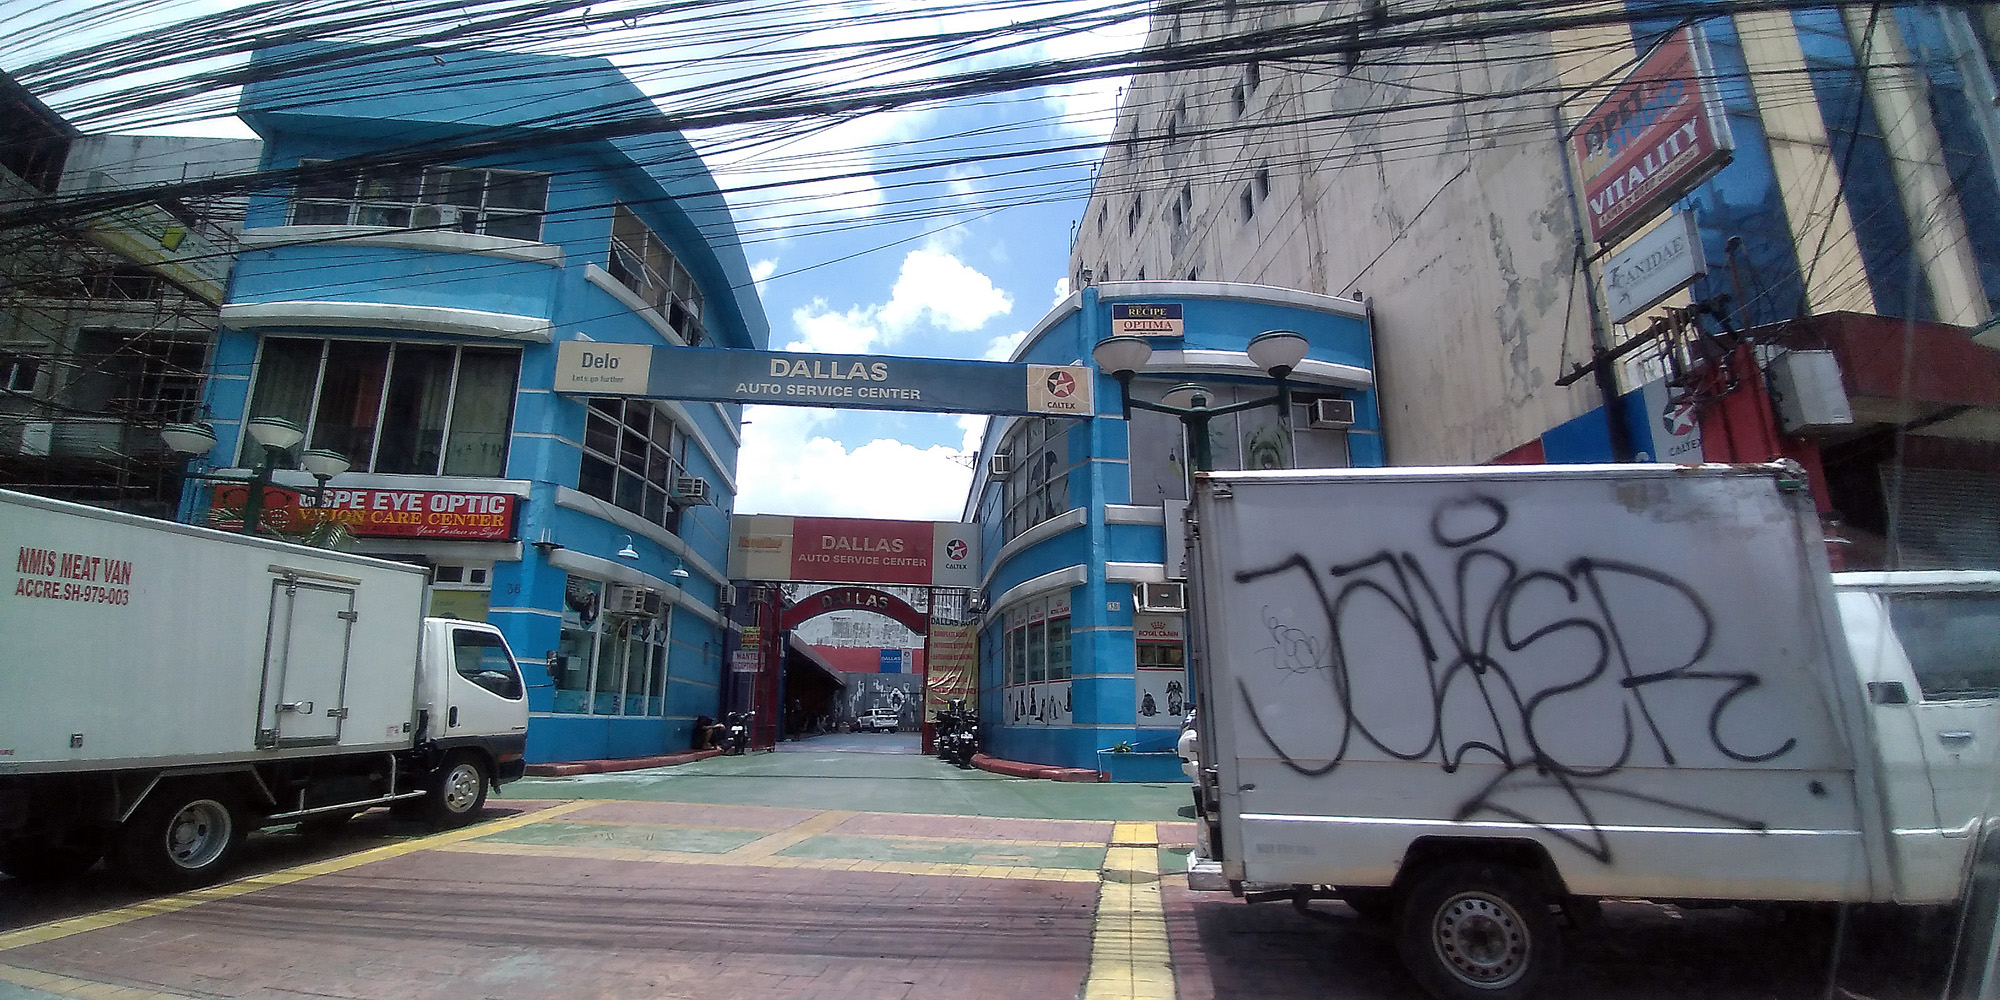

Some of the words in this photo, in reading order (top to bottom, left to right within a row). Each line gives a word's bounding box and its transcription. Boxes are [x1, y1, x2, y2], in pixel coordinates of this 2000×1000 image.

[1606, 79, 1684, 158] STUDIO
[1590, 115, 1698, 215] VITALITY
[1616, 236, 1684, 289] CANIDAE
[1128, 308, 1167, 316] RECIPE
[1123, 321, 1172, 329] OPTIMA
[582, 352, 619, 369] Delo
[770, 358, 889, 381] DALLAS
[735, 382, 782, 395] AUTO
[786, 384, 853, 397] SERVICE
[858, 386, 921, 400] CENTER
[1047, 401, 1076, 409] CALTEX
[372, 492, 425, 512] EYE
[430, 494, 507, 514] OPTIC
[371, 510, 423, 524] CARE
[428, 513, 505, 527] CENTER
[416, 525, 436, 536] Your
[479, 526, 504, 538] Sight
[821, 535, 904, 553] DALLAS
[16, 546, 57, 576] NMIS
[59, 553, 101, 582] MEAT
[104, 558, 132, 585] VAN
[798, 553, 830, 563] AUTO
[832, 555, 880, 565] SERVICE
[882, 557, 927, 567] CENTER
[930, 617, 959, 626] DALLAS
